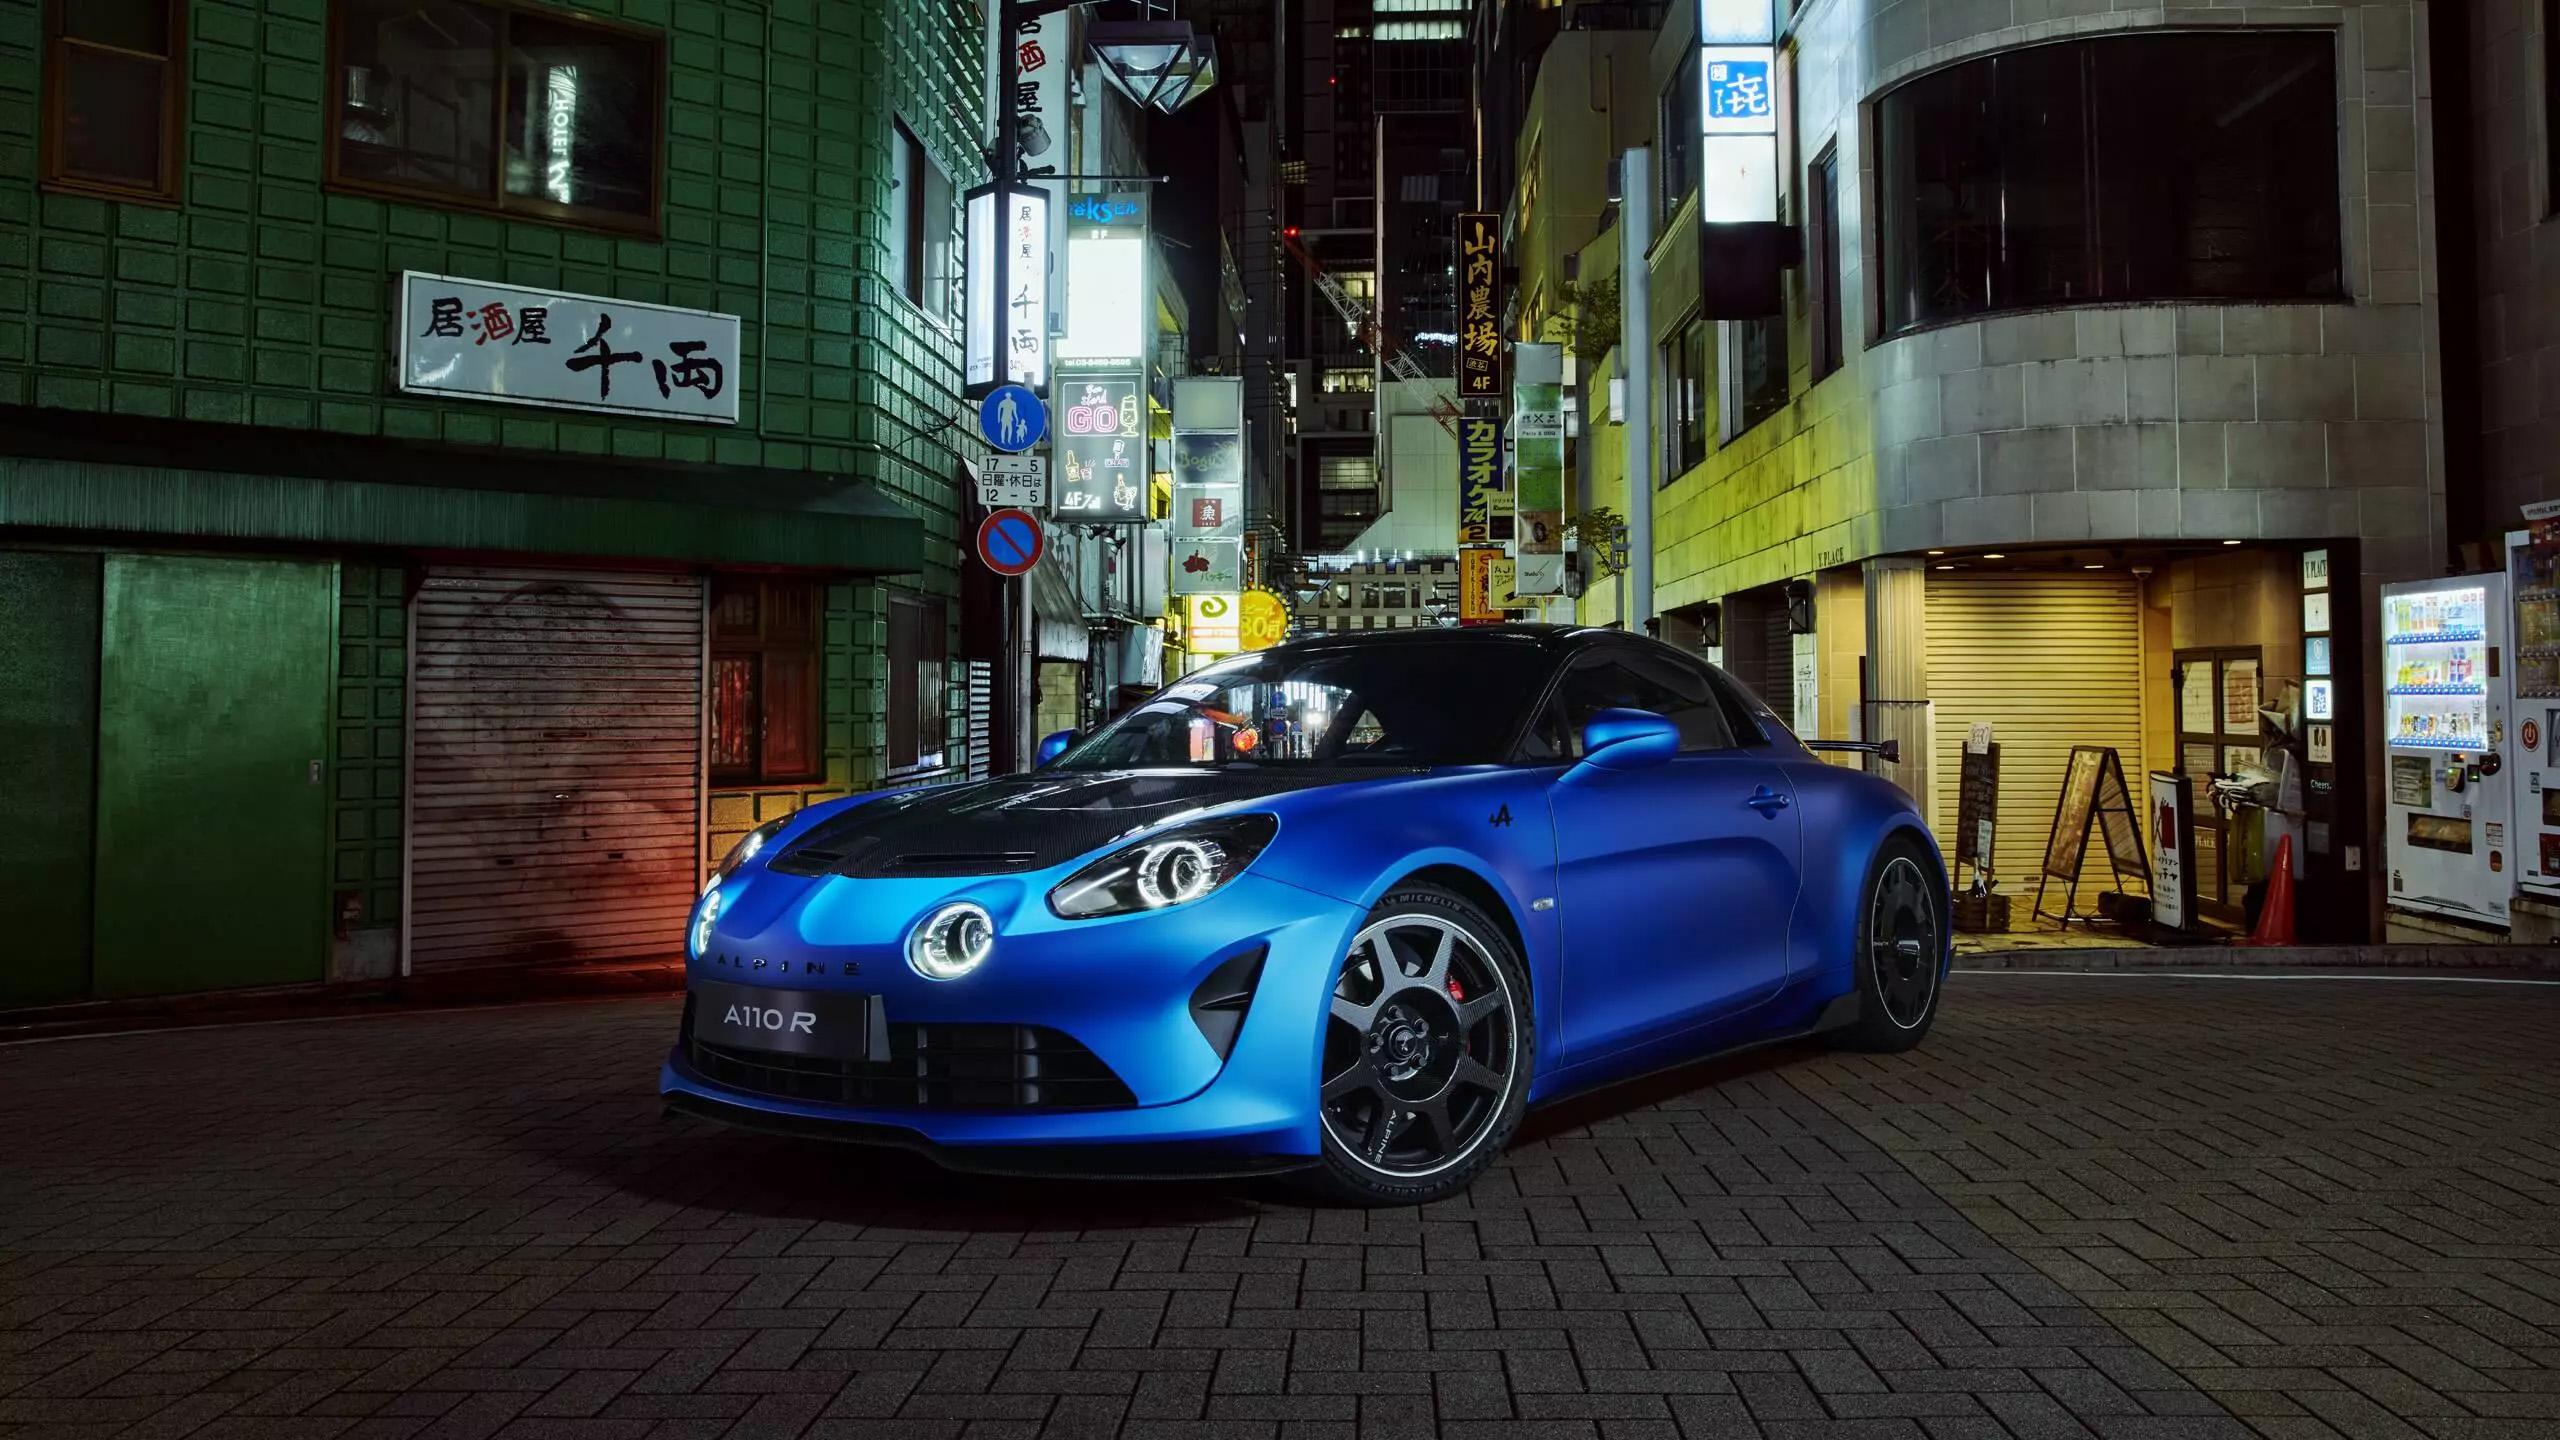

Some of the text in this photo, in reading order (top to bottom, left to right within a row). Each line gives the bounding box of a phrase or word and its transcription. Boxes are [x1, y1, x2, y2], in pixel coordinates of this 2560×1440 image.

[1464, 222, 1498, 356] 山内農場
[420, 297, 723, 401] 居酒屋 千両
[1472, 376, 1491, 389] 4F
[1068, 406, 1118, 433] GO
[986, 459, 999, 471] 17
[1030, 459, 1038, 472] 5
[1466, 420, 1497, 506] カラオケ
[986, 489, 999, 502] 12
[1030, 490, 1038, 503] 5
[1065, 492, 1082, 506] 4F
[1400, 893, 1462, 911] MICHELIN
[717, 953, 862, 975] ALPINE
[724, 1003, 817, 1034] A110 R
[1374, 1109, 1397, 1164] ALPINE
